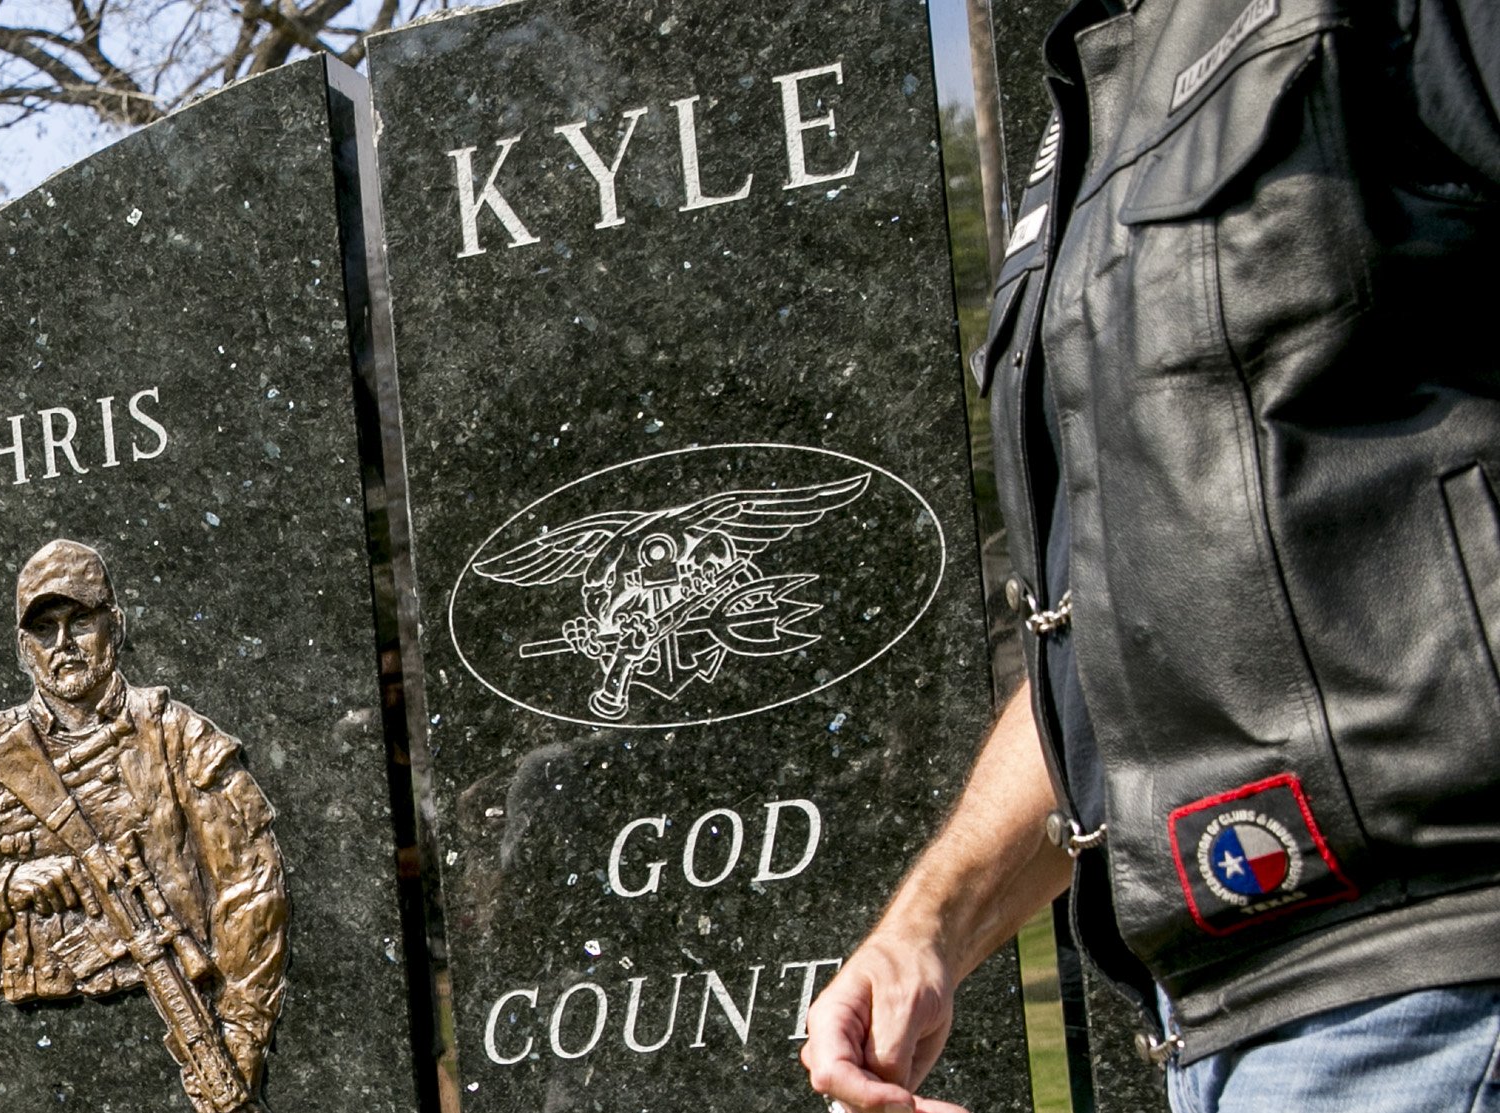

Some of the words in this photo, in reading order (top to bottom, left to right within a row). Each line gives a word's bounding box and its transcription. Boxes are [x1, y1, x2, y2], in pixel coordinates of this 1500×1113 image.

[447, 61, 860, 259] KYLE
[607, 799, 821, 898] GOD
[483, 957, 843, 1065] COUNT
